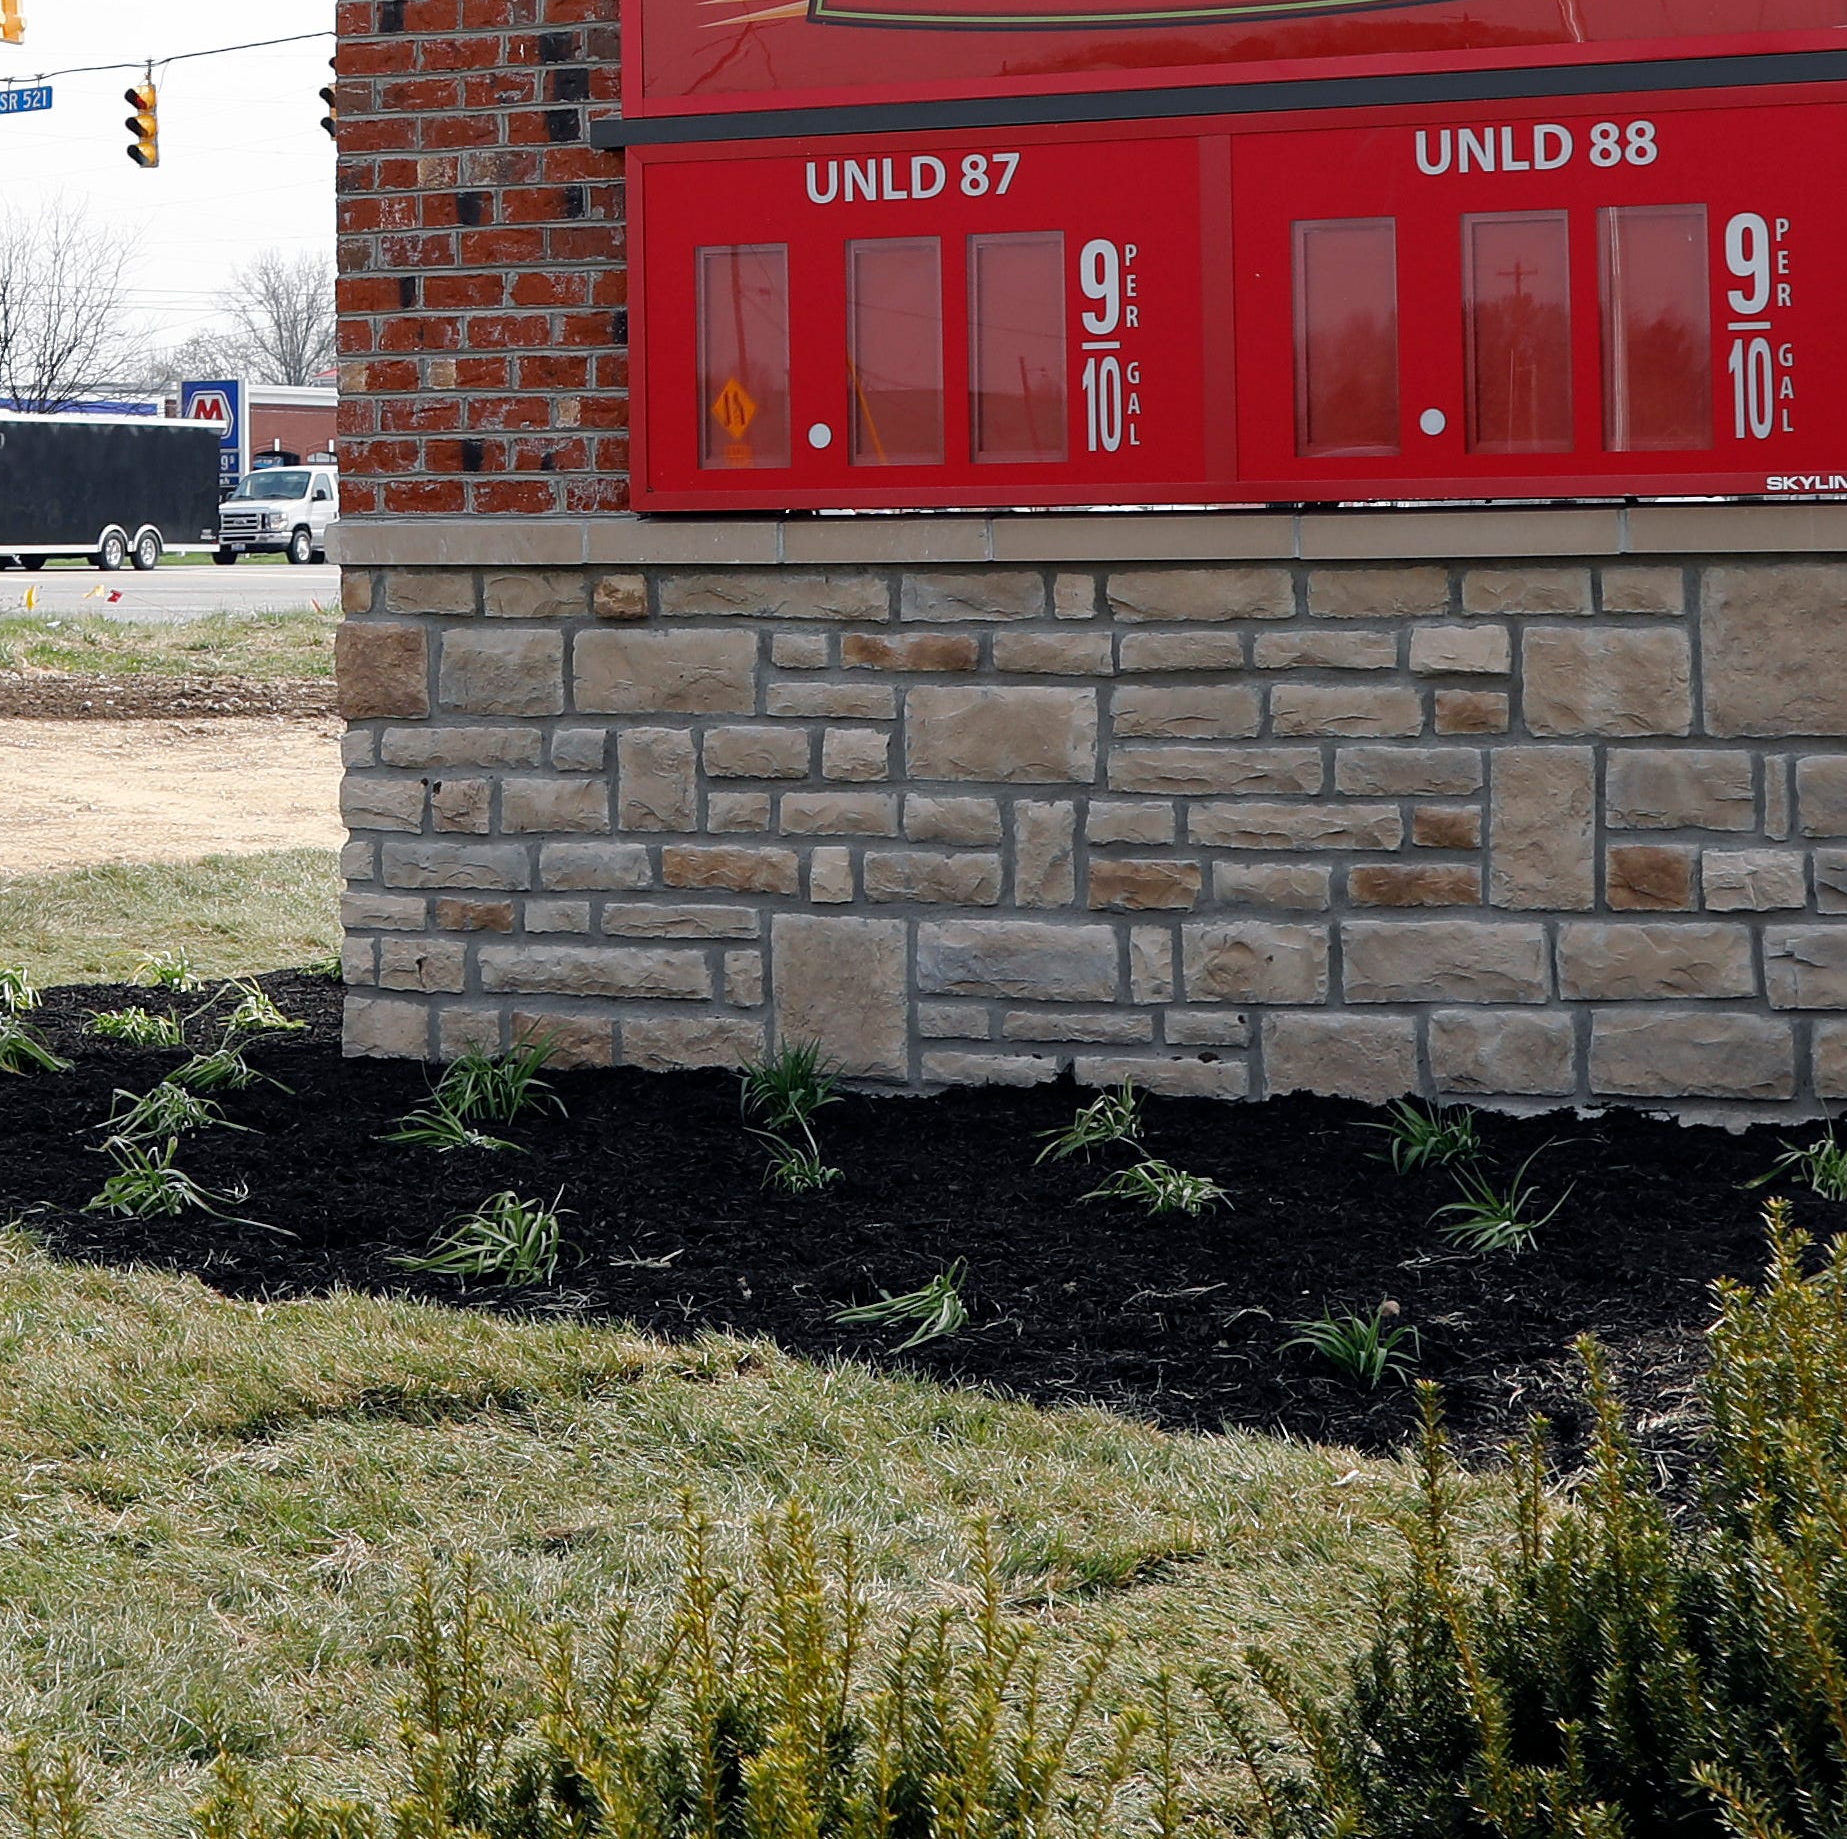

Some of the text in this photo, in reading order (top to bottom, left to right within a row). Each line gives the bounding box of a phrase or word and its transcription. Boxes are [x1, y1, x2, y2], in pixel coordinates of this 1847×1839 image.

[0, 89, 47, 111] SR 521
[805, 151, 1021, 204] UNLD 87
[1414, 119, 1658, 175] UNLD 88
[1079, 237, 1120, 336] 9
[1725, 211, 1771, 316] 9
[194, 398, 225, 420] M
[1081, 355, 1123, 452] 10
[1727, 336, 1774, 440] 10
